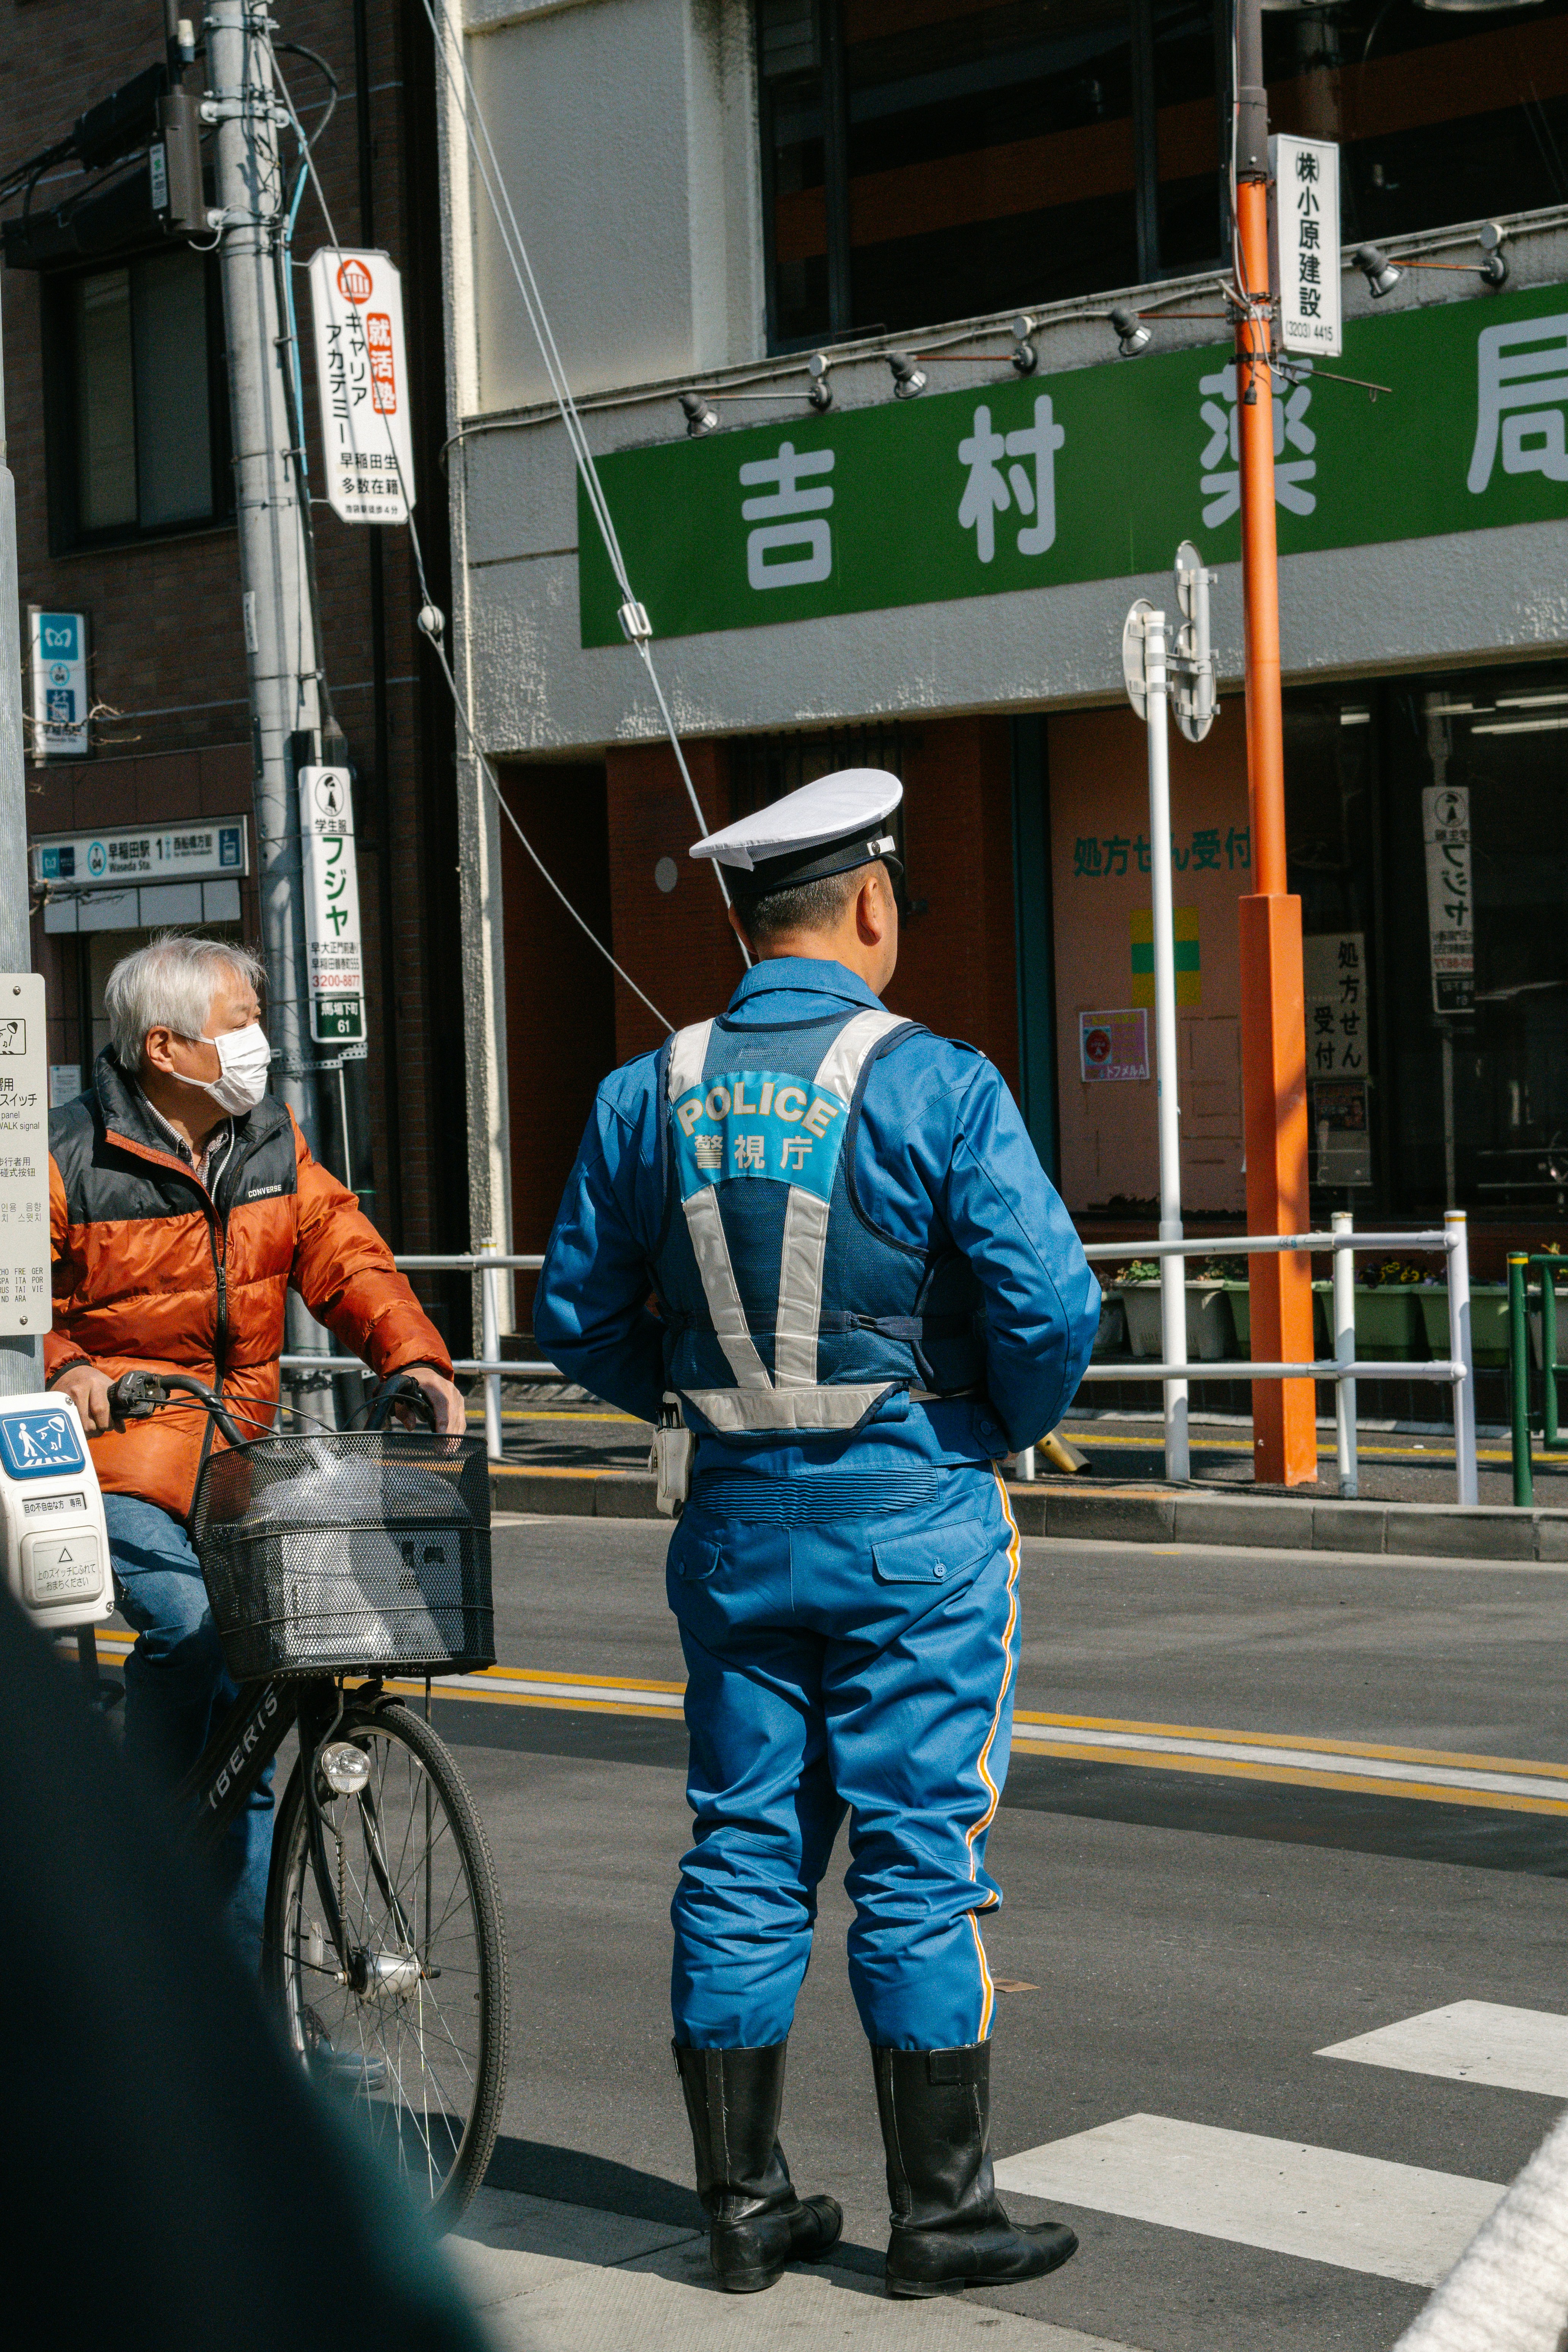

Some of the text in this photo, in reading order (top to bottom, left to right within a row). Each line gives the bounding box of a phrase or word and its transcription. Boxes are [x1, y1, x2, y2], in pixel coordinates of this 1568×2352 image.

[1286, 321, 1333, 341] (3203) 4415
[346, 312, 368, 406] キャリア
[368, 318, 395, 409] 就活塾
[326, 325, 349, 444] アカデミー
[341, 452, 398, 469] 早稲田生
[738, 315, 1568, 591] 吉村薬局
[342, 477, 398, 495] 多数在籍
[315, 819, 347, 832] 学生服
[156, 838, 163, 860] 1
[322, 837, 348, 936] フジヤ
[1338, 940, 1361, 1068] 処方せん
[338, 1020, 350, 1033] 61
[1314, 1005, 1336, 1069] 受付
[0, 1094, 37, 1106] スイッチ
[2, 1111, 20, 1120] panel
[677, 1081, 839, 1139] POLICE
[20, 1122, 40, 1132] signal
[694, 1134, 813, 1171] 警視庁
[248, 1184, 282, 1198] CONVERSE
[26, 1203, 41, 1212] 음향
[24, 1498, 82, 1513] 目の不自由な方 専用
[37, 1564, 96, 1581] 上のスイッチにふれて
[46, 1577, 89, 1591] おまちください
